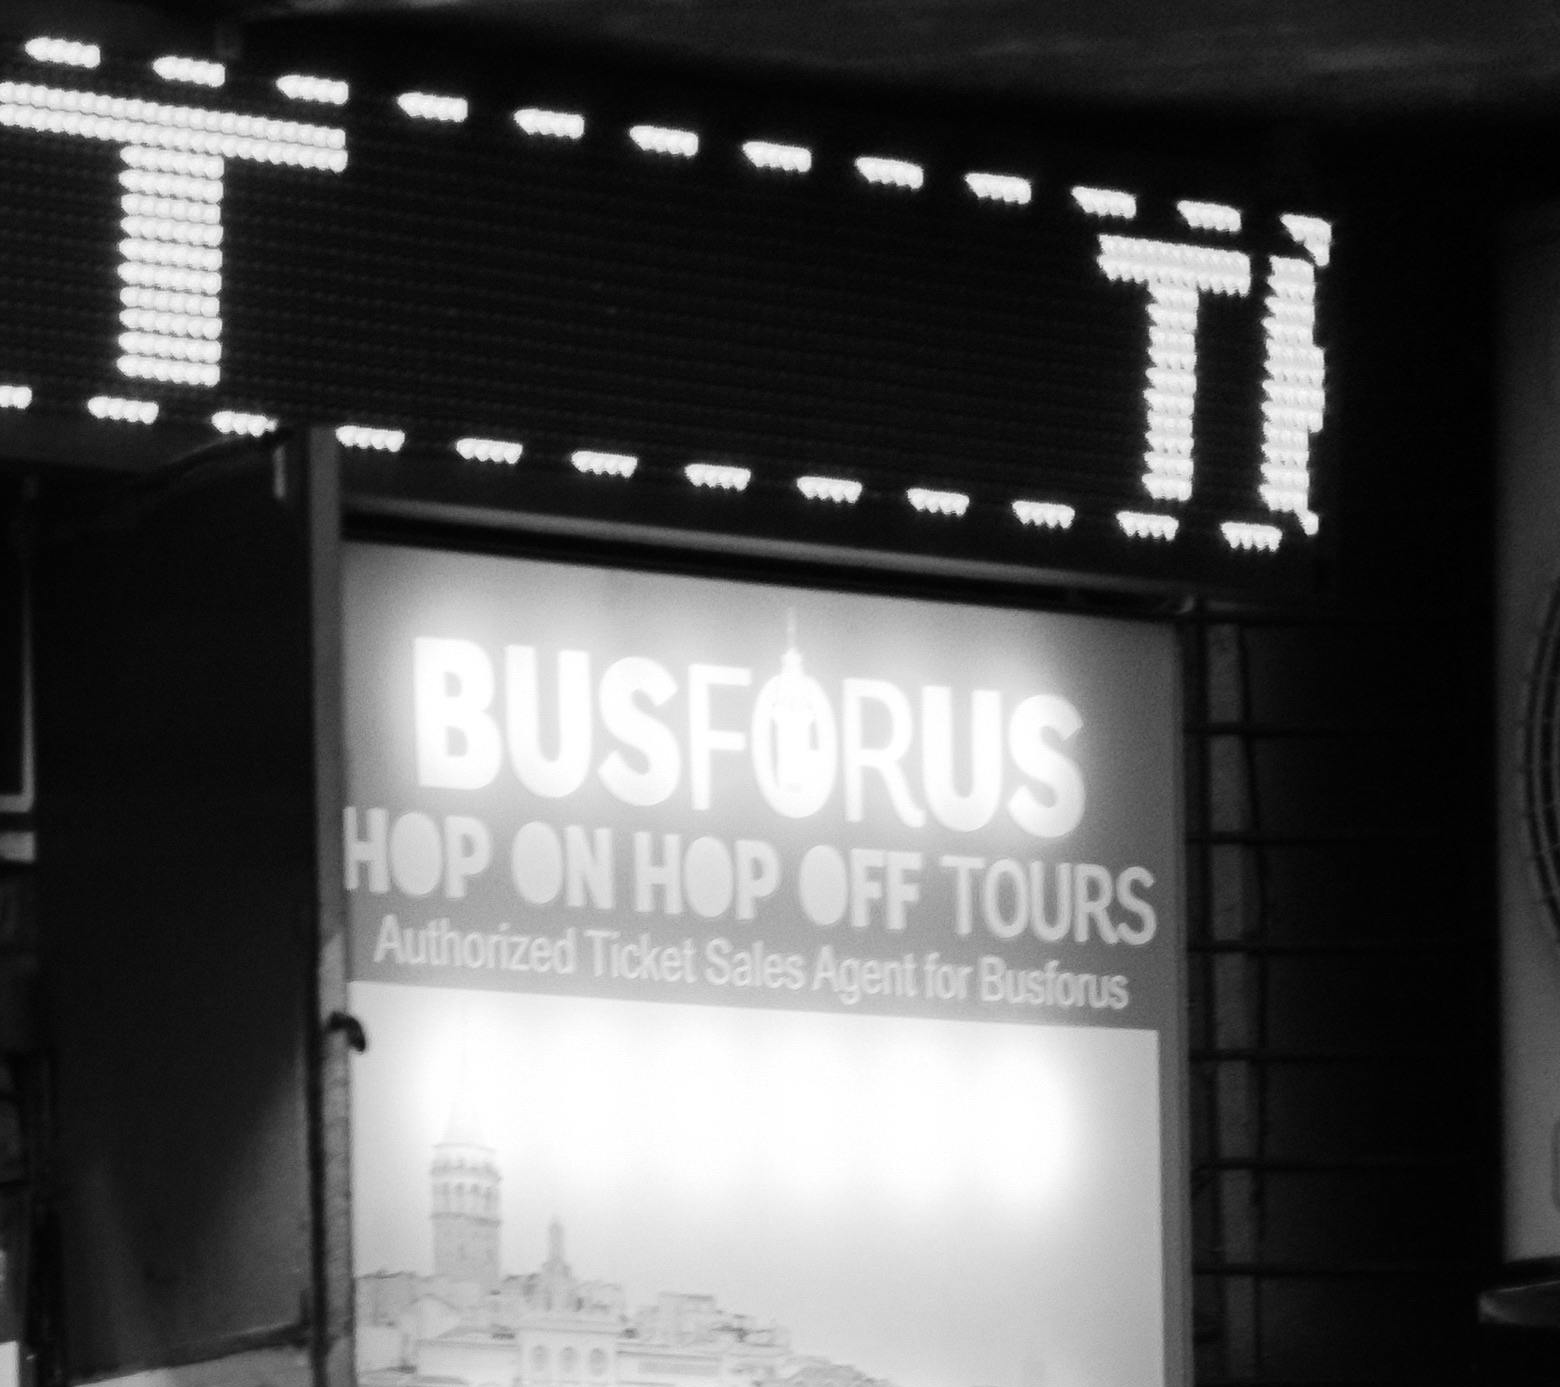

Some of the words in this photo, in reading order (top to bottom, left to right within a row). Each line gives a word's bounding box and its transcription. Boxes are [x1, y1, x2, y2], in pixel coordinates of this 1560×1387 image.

[411, 620, 1085, 839] BUSFORUS
[345, 806, 489, 899] HOP
[511, 819, 614, 911] ON
[634, 829, 780, 920] HOP
[799, 842, 922, 931] OFF
[942, 855, 1157, 948] TOURS
[374, 910, 575, 977] Authorized
[591, 924, 699, 985] Ticket
[705, 933, 803, 990] Sales
[812, 940, 918, 1006] Agent
[923, 953, 974, 1002] for
[980, 957, 1130, 1010] Busforus
